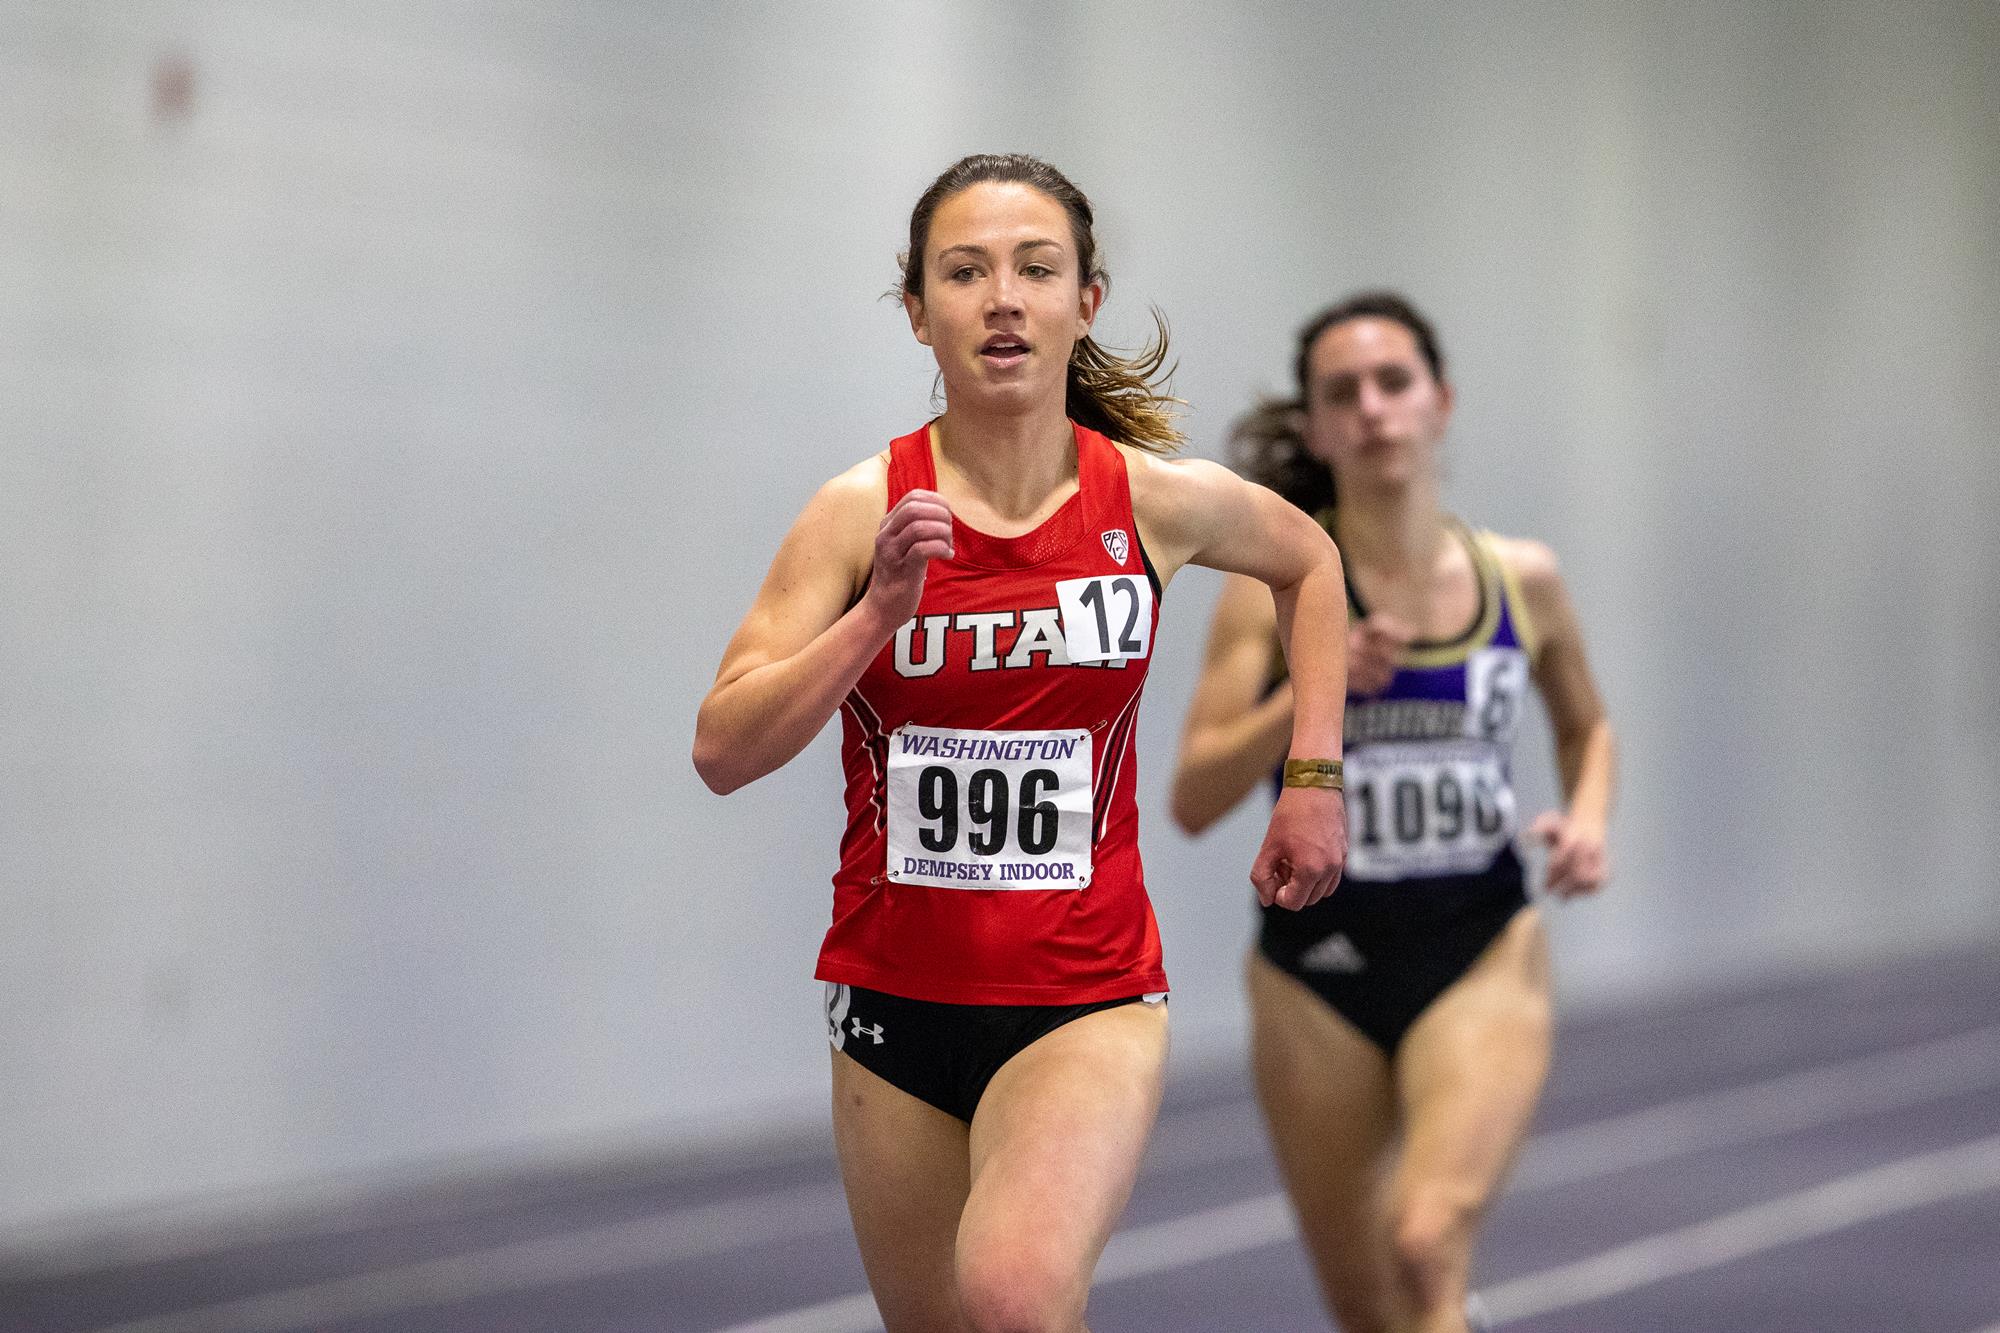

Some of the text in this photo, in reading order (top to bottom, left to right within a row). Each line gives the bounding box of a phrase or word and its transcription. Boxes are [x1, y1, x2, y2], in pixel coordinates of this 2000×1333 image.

[1102, 530, 1128, 552] PAC
[1112, 546, 1127, 560] 12
[1079, 577, 1142, 654] 12
[893, 606, 1129, 679] UTA
[901, 733, 1079, 761] WASHINGTON
[918, 765, 1060, 856] 996
[903, 857, 1075, 881] DEMPSEY INDOOR
